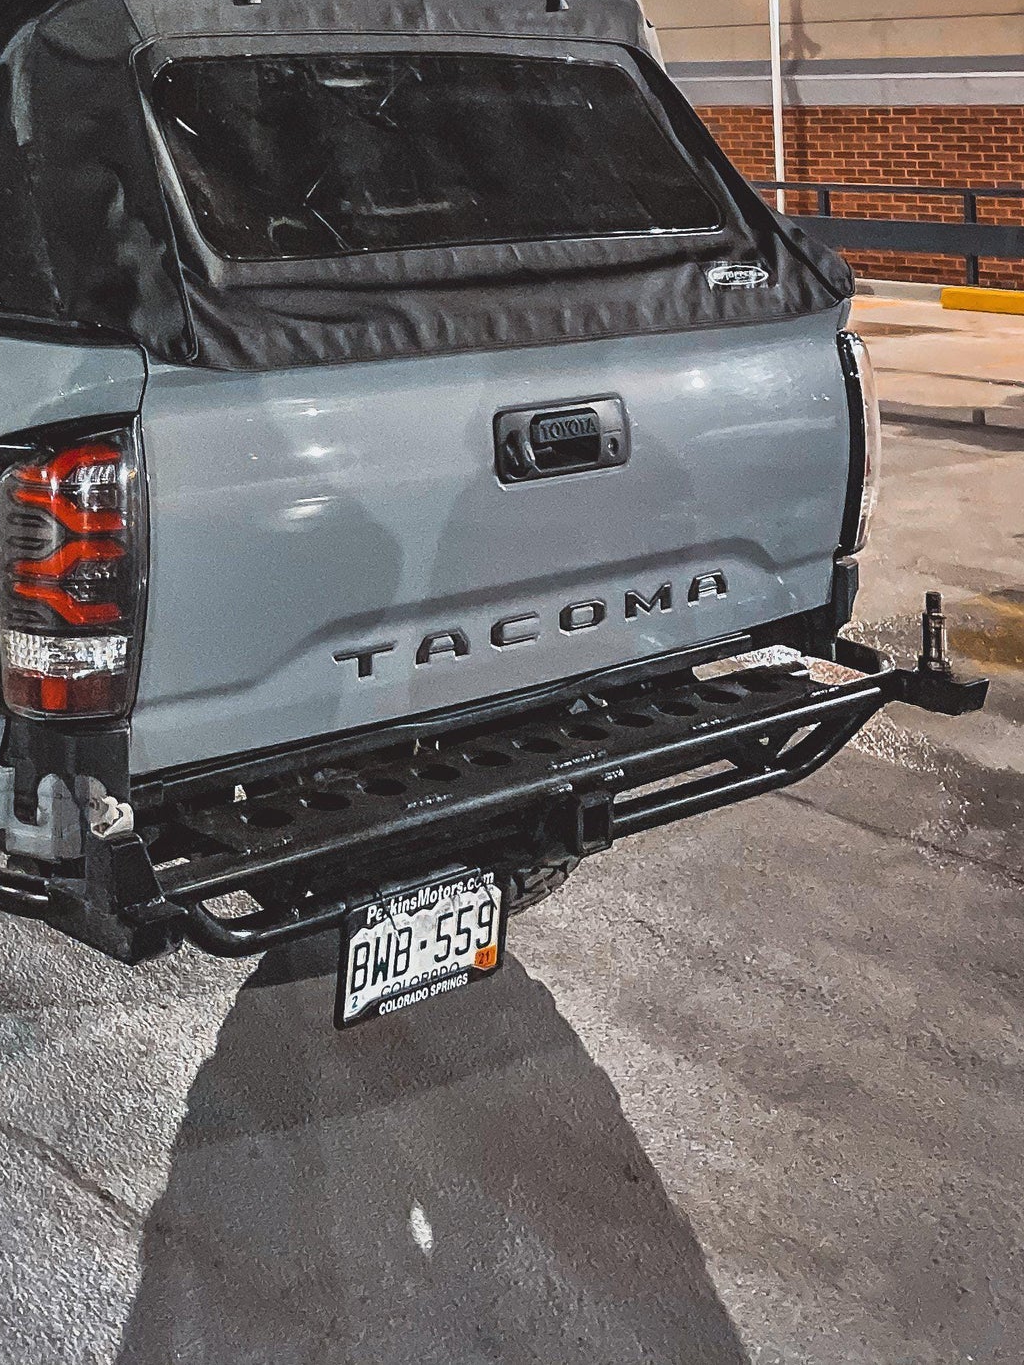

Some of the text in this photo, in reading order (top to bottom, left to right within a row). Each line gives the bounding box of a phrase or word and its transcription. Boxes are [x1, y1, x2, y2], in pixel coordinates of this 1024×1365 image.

[540, 417, 597, 440] TOYOTA
[331, 568, 729, 681] TACOMA
[366, 871, 495, 925] PekinsMotors.com
[478, 949, 490, 965] 21
[379, 972, 469, 1016] COLORADO SPRINGS
